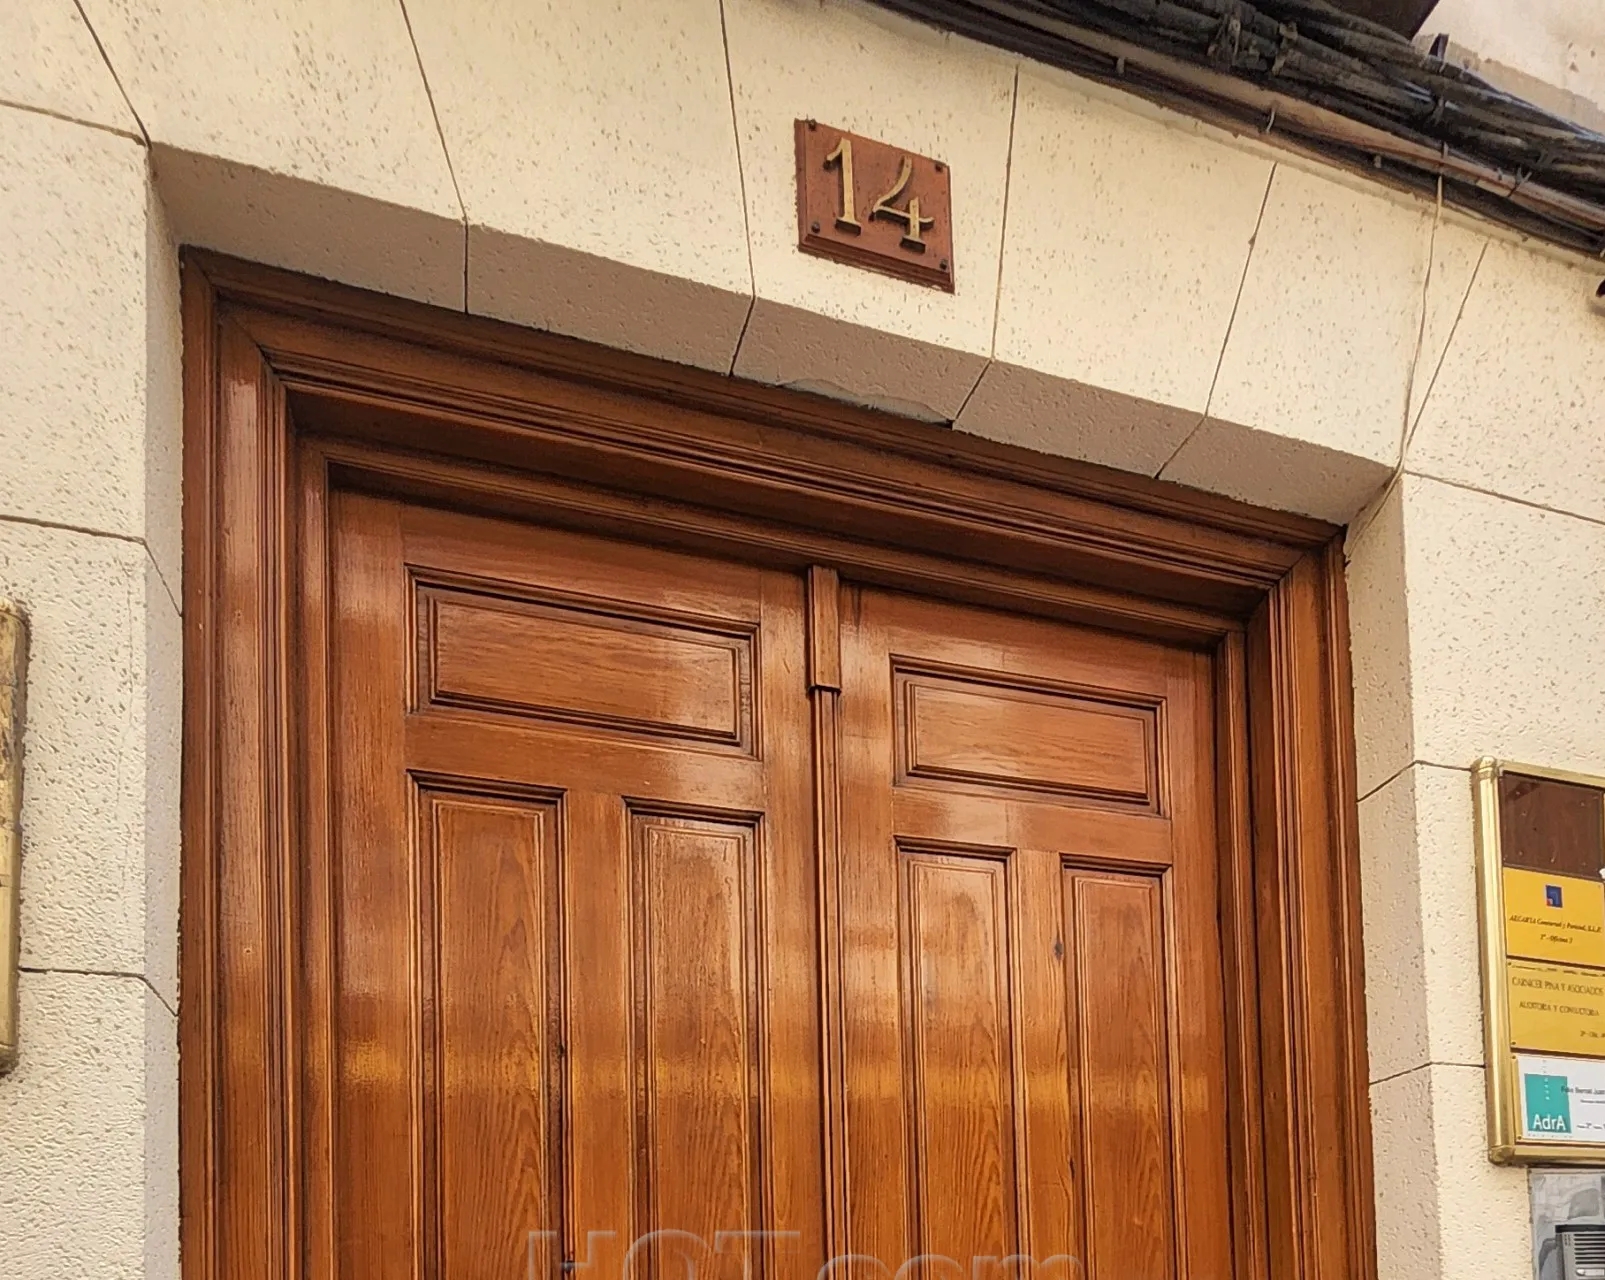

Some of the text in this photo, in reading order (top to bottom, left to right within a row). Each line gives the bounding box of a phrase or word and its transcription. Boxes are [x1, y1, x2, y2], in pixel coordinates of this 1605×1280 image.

[824, 136, 935, 253] 14
[1568, 984, 1604, 996] ASOCIADOS
[1533, 1113, 1566, 1131] AdrA
